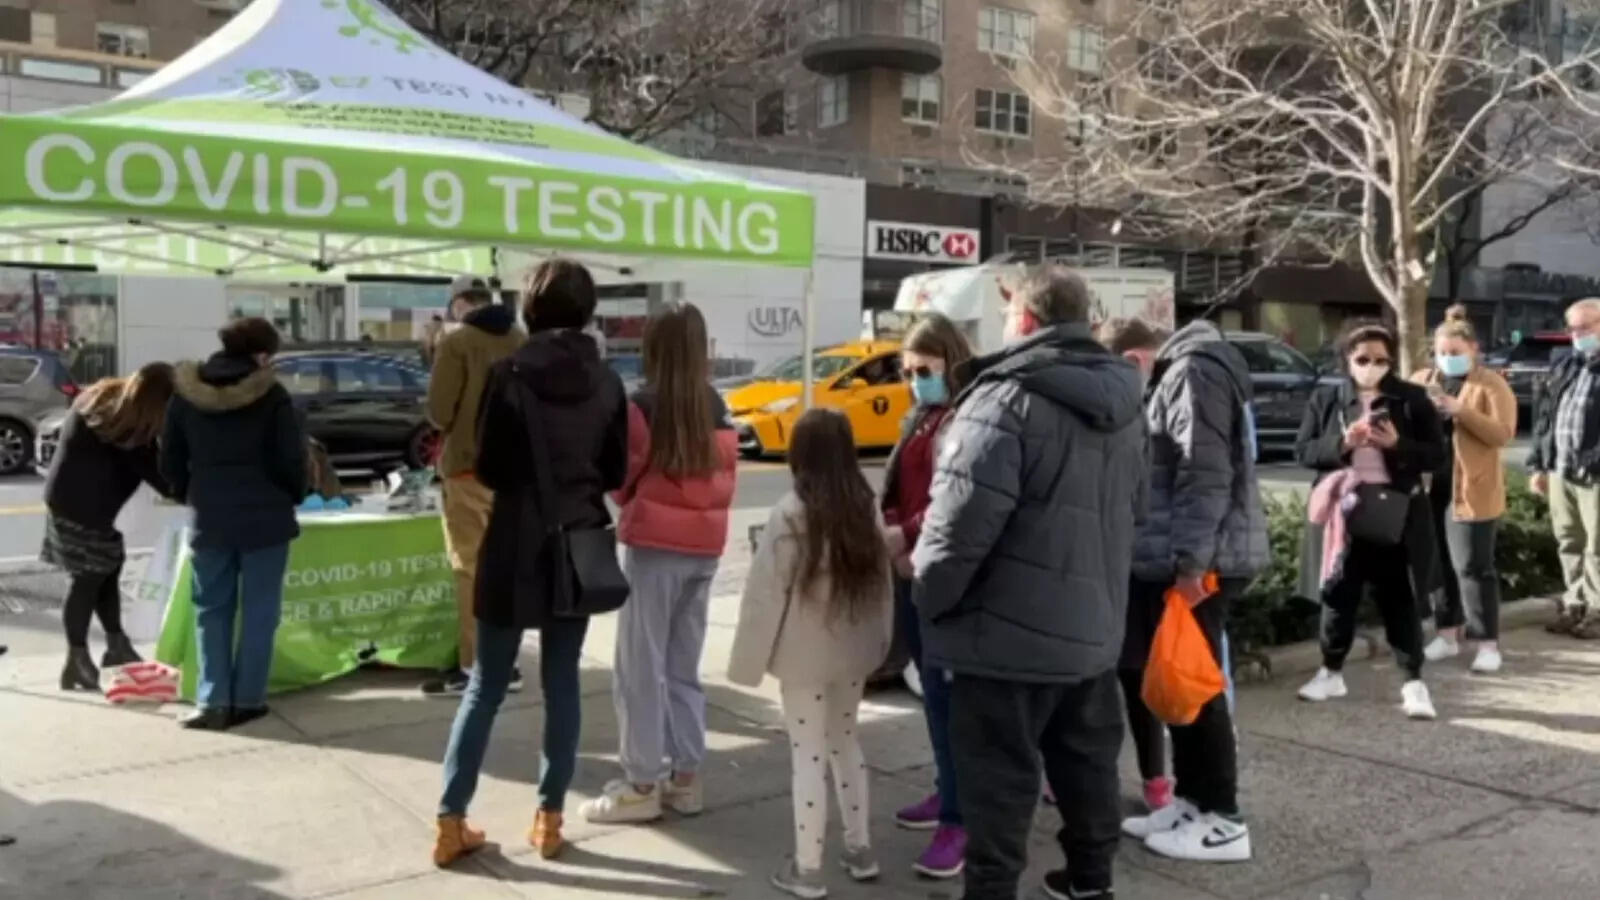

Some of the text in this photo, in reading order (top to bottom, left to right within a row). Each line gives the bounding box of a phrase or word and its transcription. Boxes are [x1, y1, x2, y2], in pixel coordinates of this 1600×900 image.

[25, 133, 463, 228] COVID-19
[488, 176, 779, 255] TESTING
[876, 227, 940, 256] HSBC
[752, 306, 803, 333] ULTA
[284, 554, 451, 587] COVID-19 TEST
